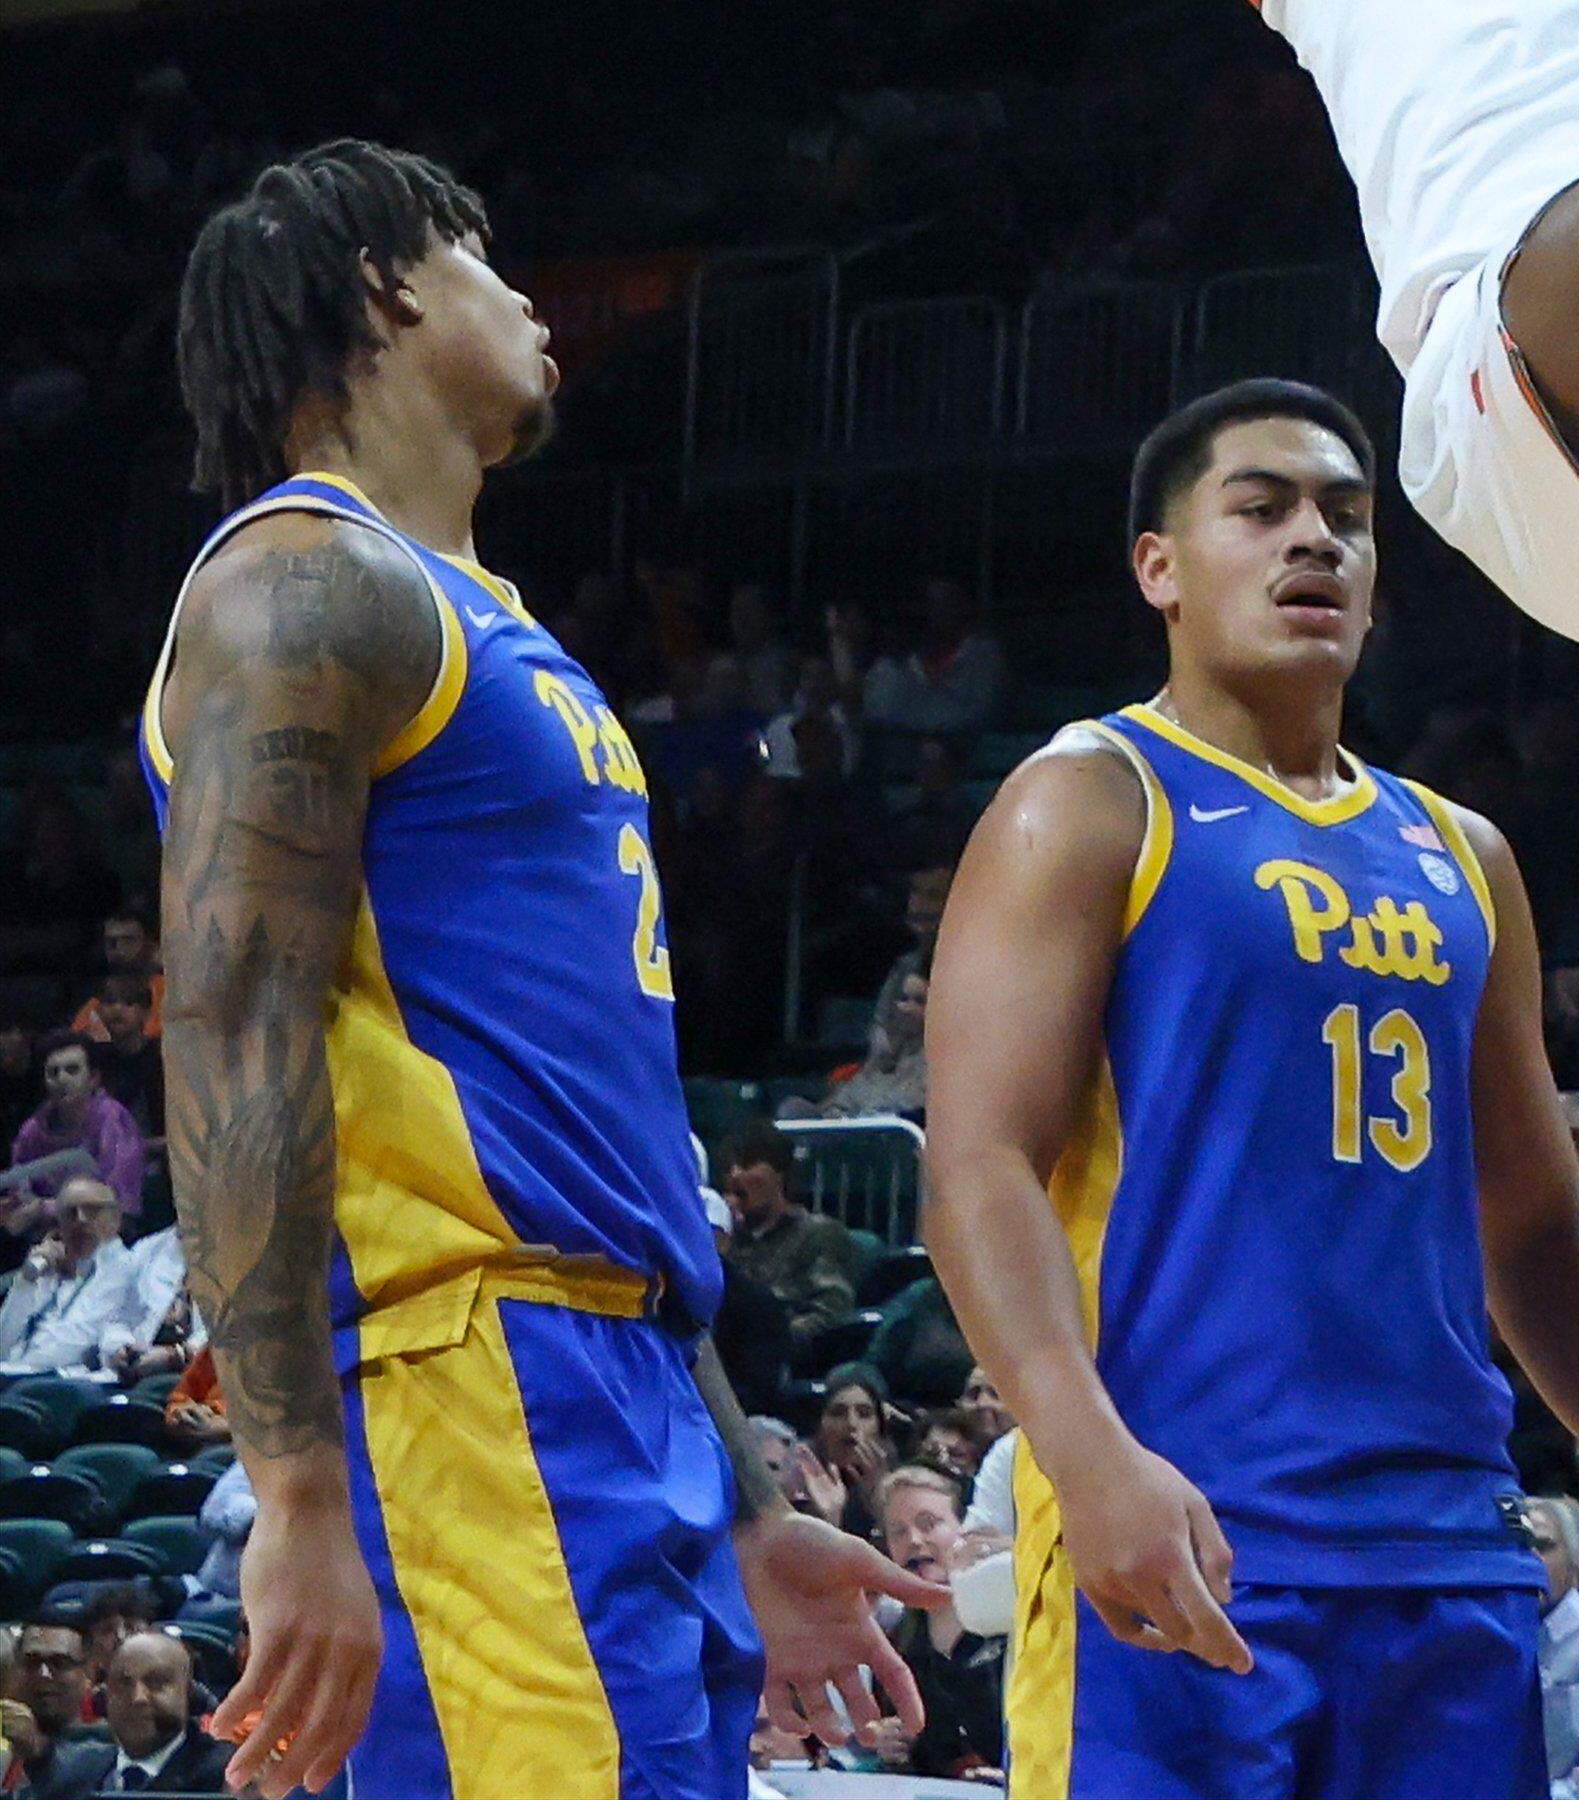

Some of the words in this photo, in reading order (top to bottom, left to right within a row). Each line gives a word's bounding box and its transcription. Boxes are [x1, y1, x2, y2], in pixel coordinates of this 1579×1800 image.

[618, 822, 675, 1001] 2
[1254, 859, 1450, 986] Pitt
[1323, 1003, 1432, 1172] 13
